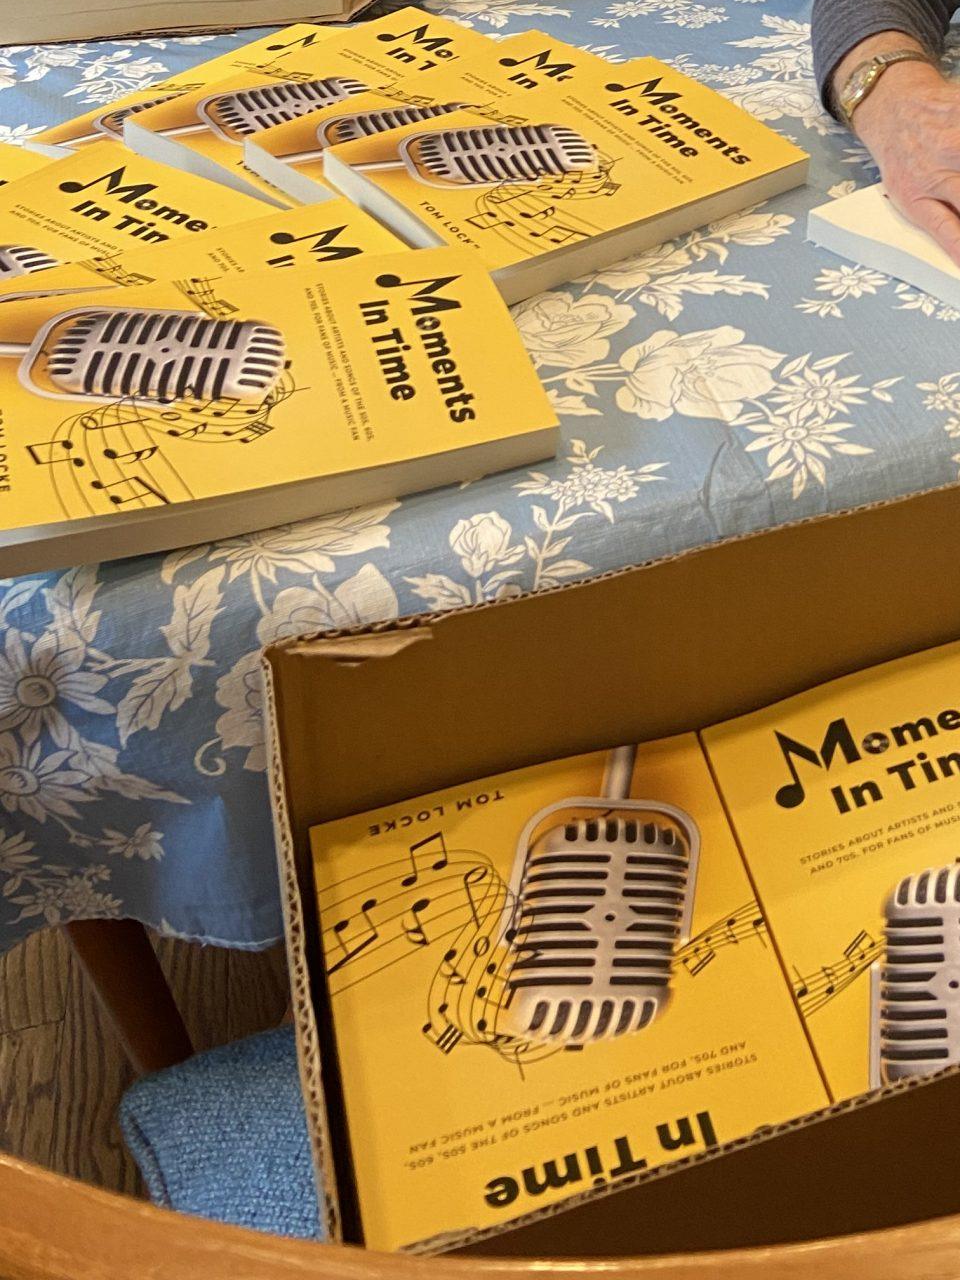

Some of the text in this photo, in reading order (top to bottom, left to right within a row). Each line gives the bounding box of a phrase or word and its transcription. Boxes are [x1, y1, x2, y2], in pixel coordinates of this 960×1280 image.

[385, 47, 417, 63] In
[507, 72, 539, 90] In
[604, 76, 751, 165] Moments
[608, 98, 699, 158] In Time
[59, 165, 210, 232] Mome
[70, 200, 111, 222] In
[419, 201, 445, 219] TOM
[325, 305, 336, 324] ABOUT
[345, 364, 357, 386] SONGS
[359, 300, 416, 401] In Time
[375, 274, 476, 423] Moments
[831, 781, 883, 814] In
[369, 790, 504, 836] TOM LOCKE
[799, 843, 846, 864] STORIES
[848, 828, 884, 847] ABOUT
[887, 812, 930, 832] ARTISTS
[932, 804, 954, 817] AND
[810, 860, 834, 874] AND
[862, 842, 884, 855] FOR
[886, 831, 915, 845] FANS
[917, 823, 931, 834] OF
[720, 1041, 746, 1056] AND
[662, 1058, 687, 1073] FOR
[706, 1053, 758, 1075] STORIES
[604, 1079, 622, 1092] OF
[625, 1067, 658, 1085] FANS
[660, 1069, 702, 1087] ABOUT
[559, 1086, 600, 1106] MUSIC
[604, 1084, 656, 1107] ARTISTS
[502, 1105, 540, 1125] FROM
[572, 1101, 600, 1118] AND
[523, 1113, 569, 1133] SONGS
[440, 1124, 484, 1145] MUSIC
[471, 1135, 498, 1151] THE
[501, 1128, 519, 1142] OF
[409, 1138, 437, 1154] FAN
[484, 1110, 718, 1209] In Time
